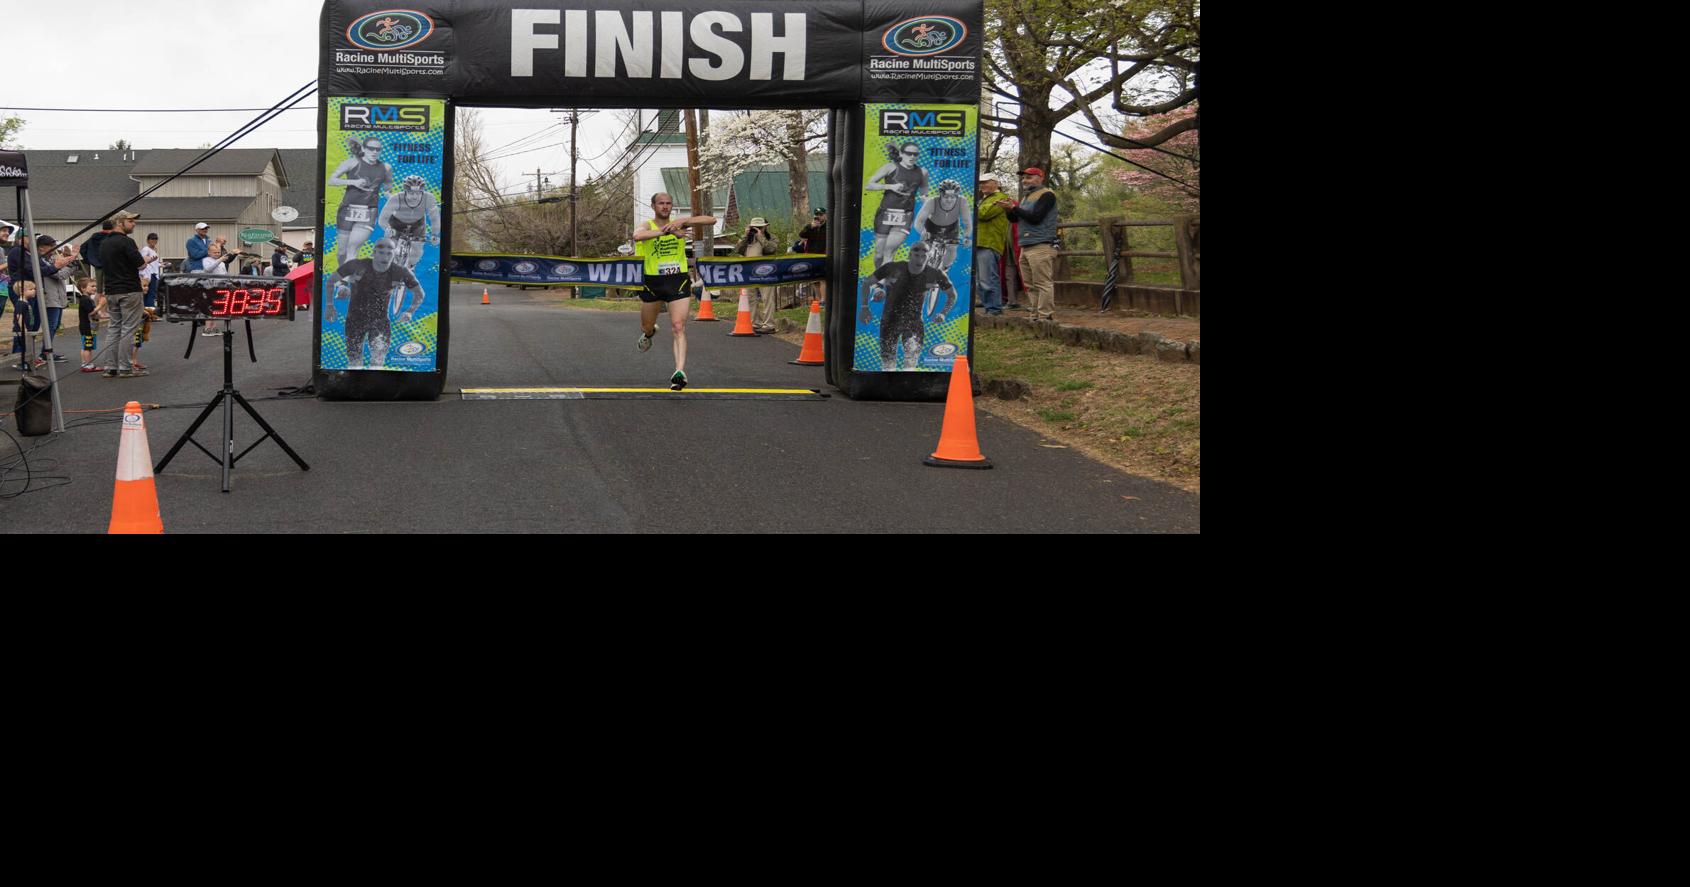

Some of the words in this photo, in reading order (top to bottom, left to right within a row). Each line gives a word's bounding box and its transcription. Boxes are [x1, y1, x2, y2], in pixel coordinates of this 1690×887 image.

[510, 8, 807, 81] FINISH
[336, 52, 374, 63] Racine
[378, 53, 444, 66] MultiSports
[870, 58, 909, 69] Racine
[912, 59, 975, 71] MultiSports
[336, 67, 444, 76] www.RacineMultiSports.com
[870, 72, 974, 81] www.RacineMultiSports.com
[344, 105, 426, 125] RMS
[883, 112, 962, 130] RMS
[398, 154, 415, 163] FOR
[934, 159, 950, 168] FOR
[588, 263, 642, 283] WIN
[212, 288, 284, 315] 38:35
